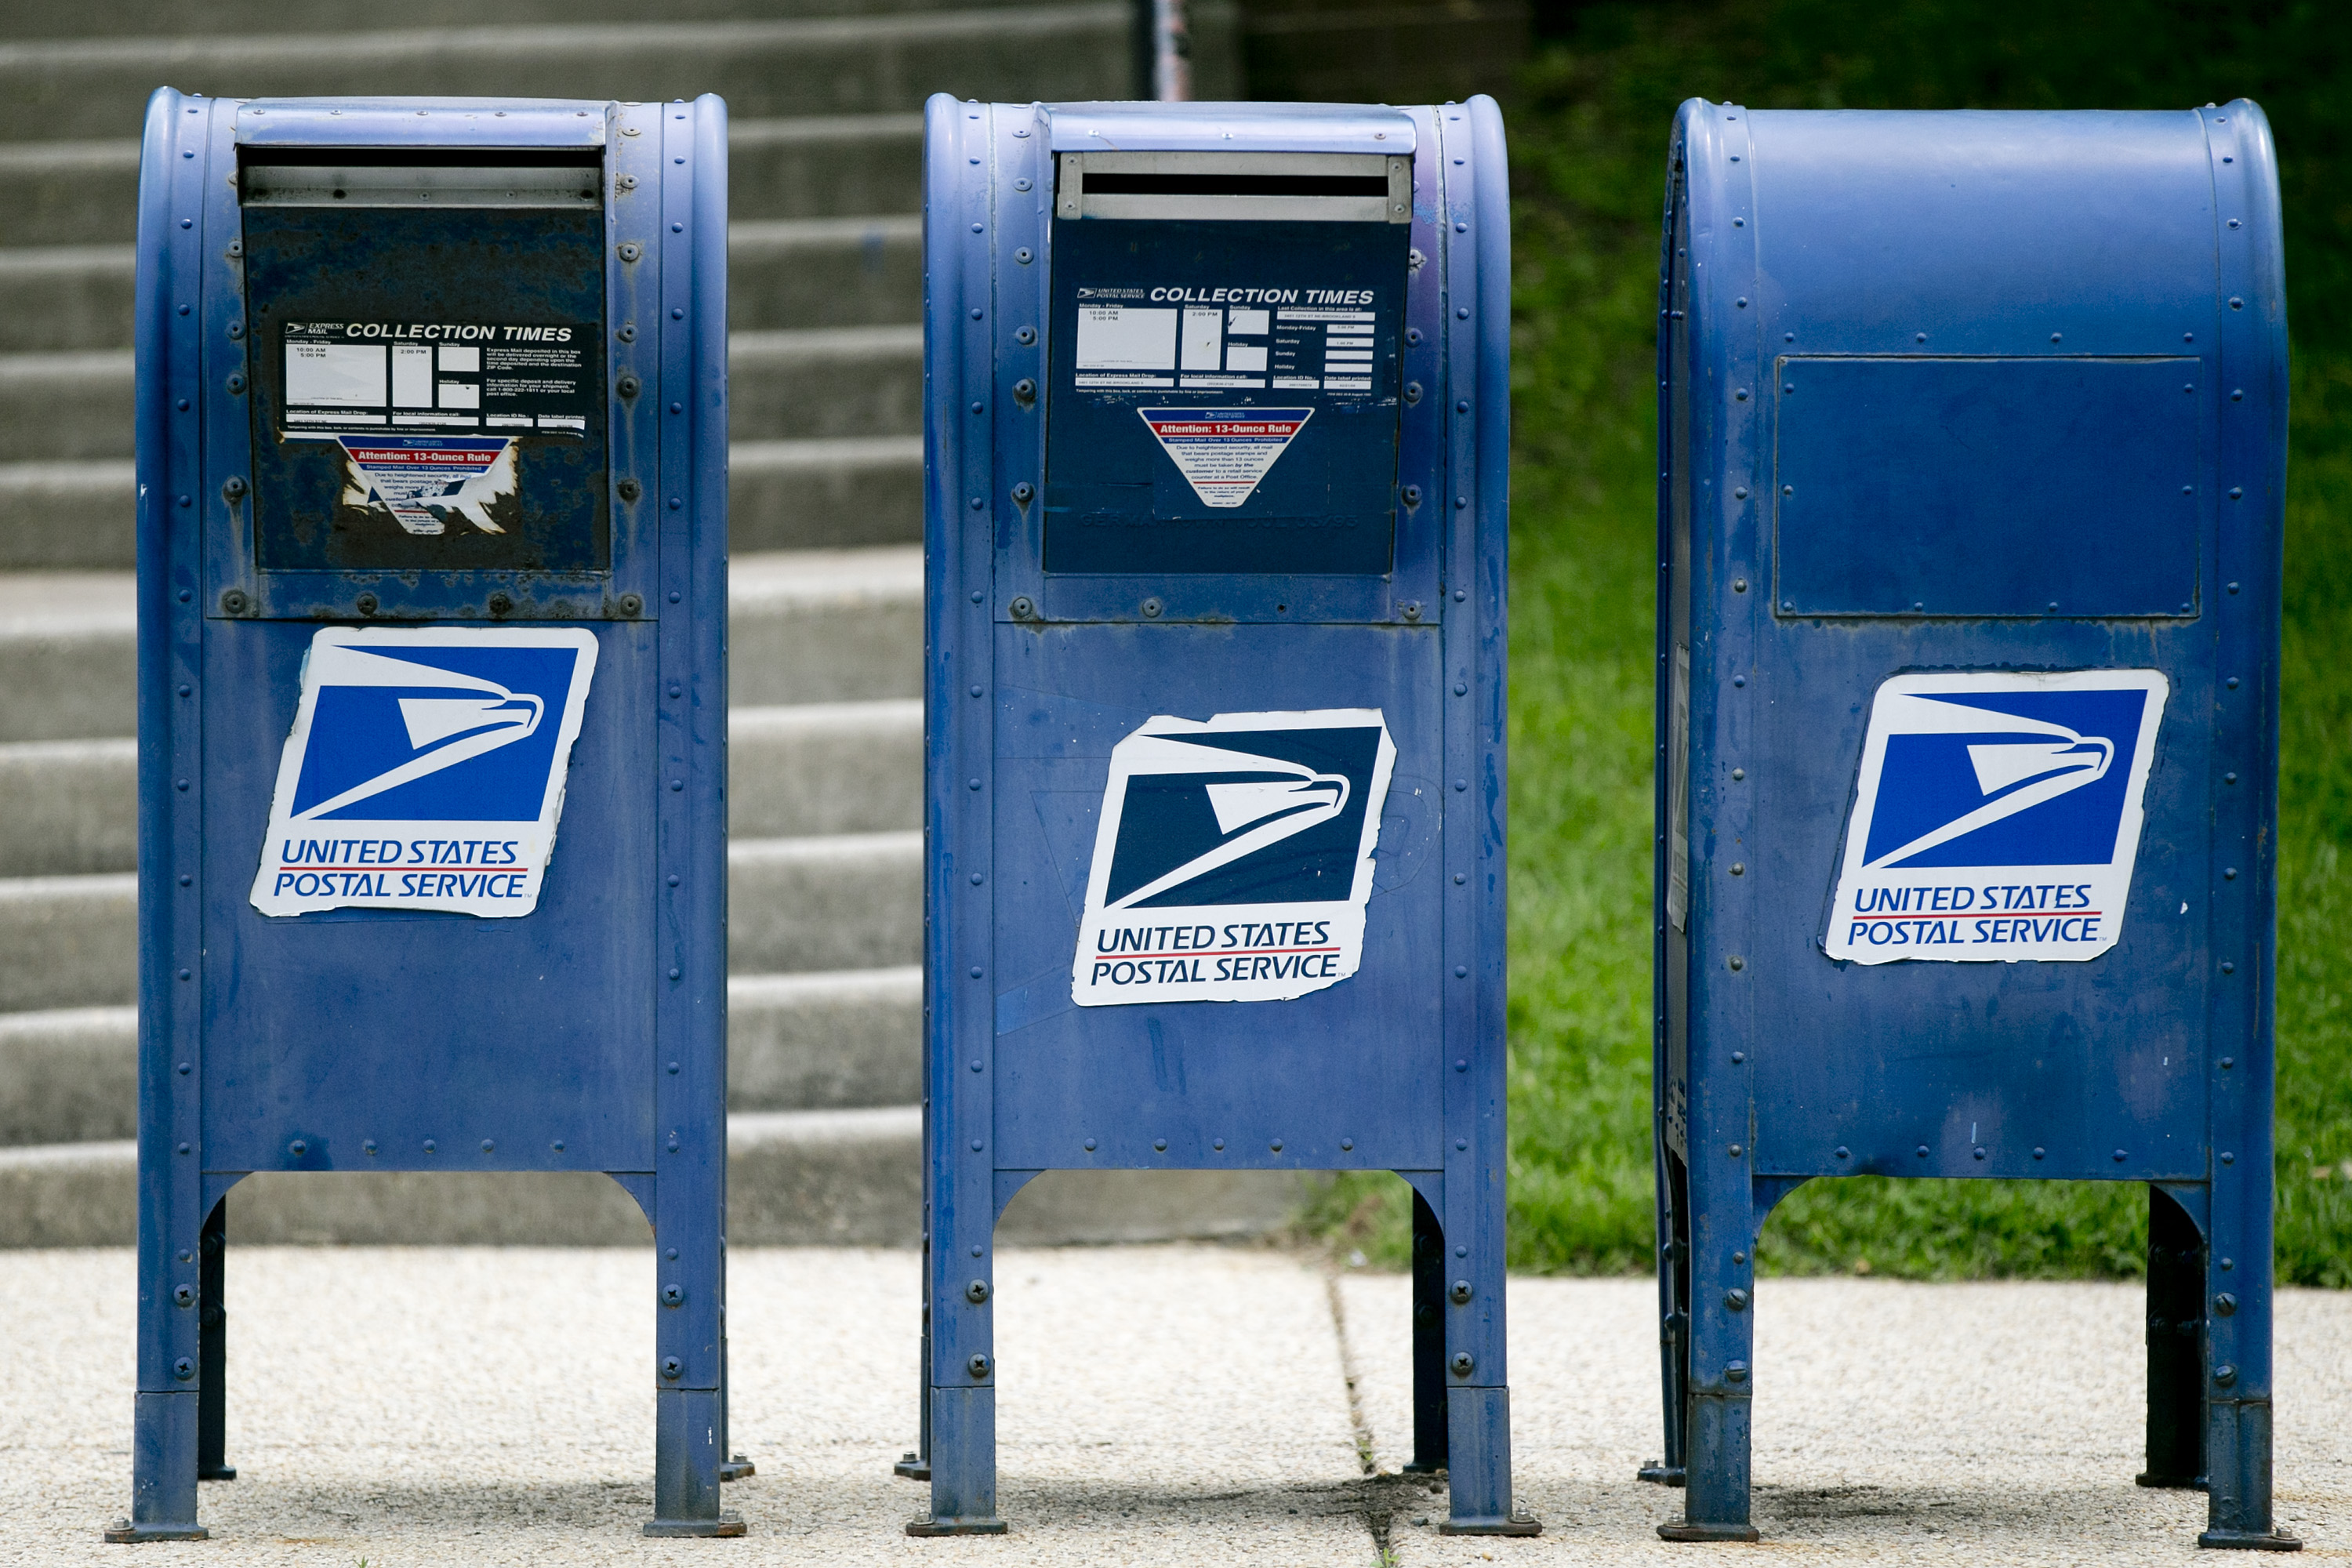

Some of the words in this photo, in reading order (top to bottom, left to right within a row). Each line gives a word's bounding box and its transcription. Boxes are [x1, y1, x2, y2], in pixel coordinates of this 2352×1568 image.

[1151, 287, 1299, 303] COLLECTION
[1306, 290, 1374, 304] TIMES
[347, 323, 496, 339] COLLECTION
[504, 327, 572, 341] TIMES
[1161, 425, 1212, 433] Attention:
[1215, 425, 1265, 433] 13-Ounce
[1268, 425, 1292, 433] Rule
[358, 452, 410, 460] Attention:
[414, 452, 464, 461] 13-Ounce
[282, 840, 402, 863] UNITED
[407, 840, 517, 864] STATES
[274, 873, 391, 897] POSTAL
[398, 874, 527, 898] SERVICE
[1855, 887, 1975, 912] UNITED
[1979, 884, 2092, 909] STATES
[1098, 925, 1215, 952] UNITED
[1221, 921, 1330, 947] STATES
[1848, 920, 1965, 946] POSTAL
[1973, 918, 2101, 943] SERVICE
[1091, 960, 1206, 986] POSTAL
[1214, 954, 1340, 981] SERVICE
